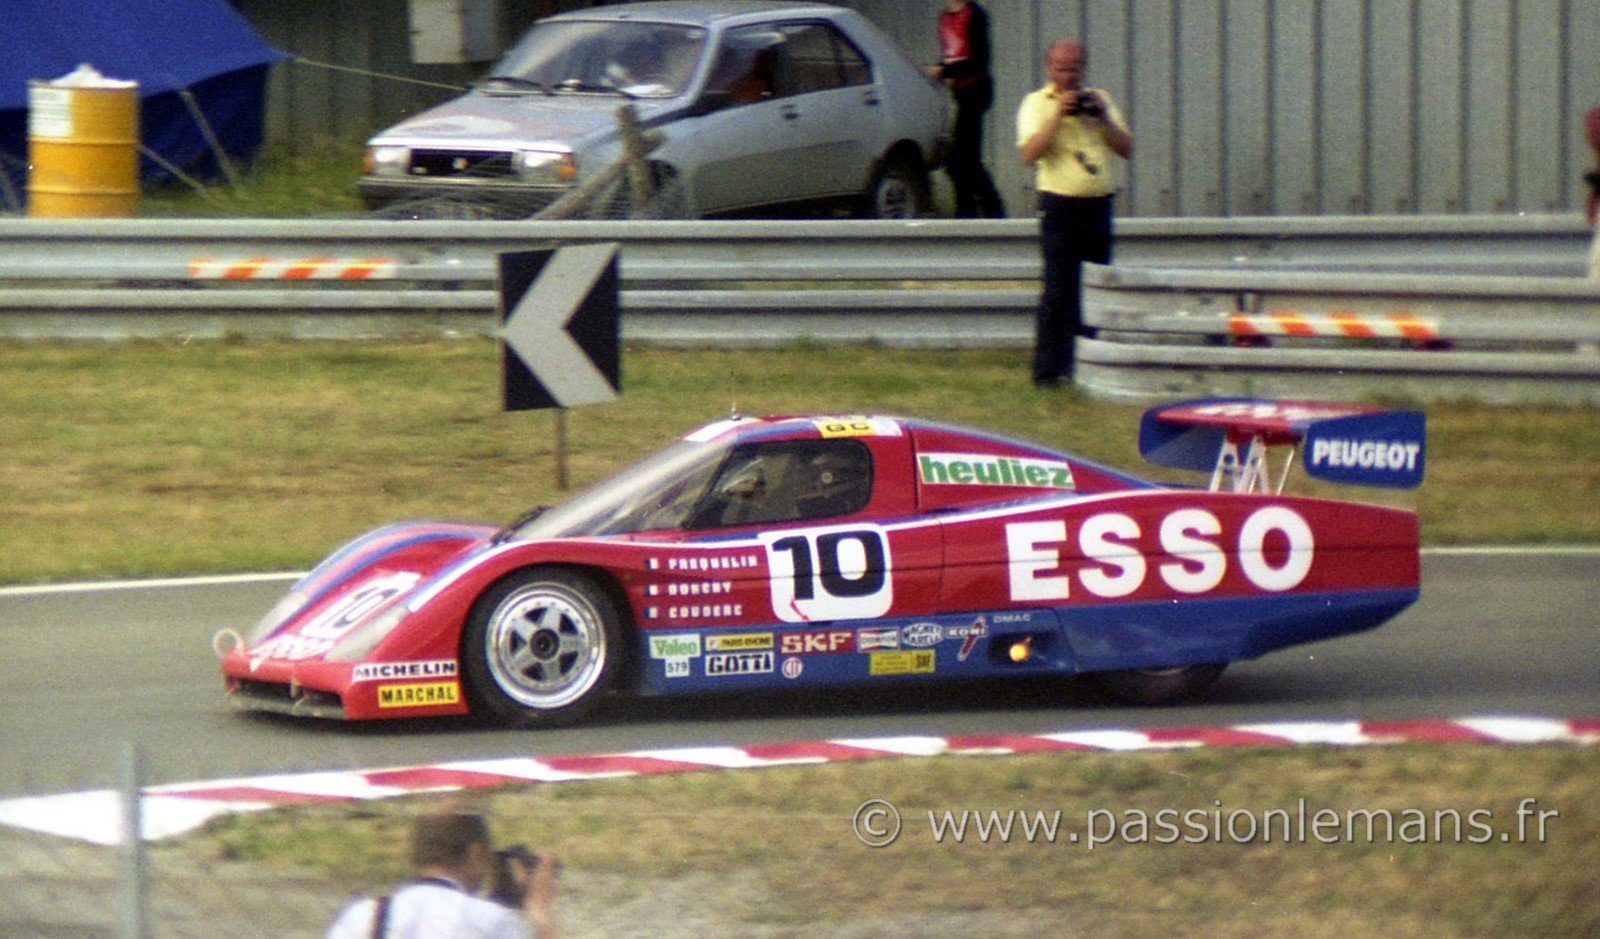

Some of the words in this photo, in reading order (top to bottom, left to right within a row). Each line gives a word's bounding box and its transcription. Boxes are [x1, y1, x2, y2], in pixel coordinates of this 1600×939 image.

[1312, 439, 1420, 470] PEUGEOT
[919, 455, 1075, 487] heuliez
[1005, 506, 1314, 601] ESSO
[771, 530, 887, 600] 10
[318, 586, 400, 629] 10
[780, 631, 853, 654] SKF
[948, 627, 987, 637] KONI
[654, 638, 698, 656] Valeo
[355, 661, 457, 678] MICHELIN
[667, 661, 688, 673] 579
[708, 653, 772, 673] GOTTI
[381, 685, 456, 704] MARCHAL
